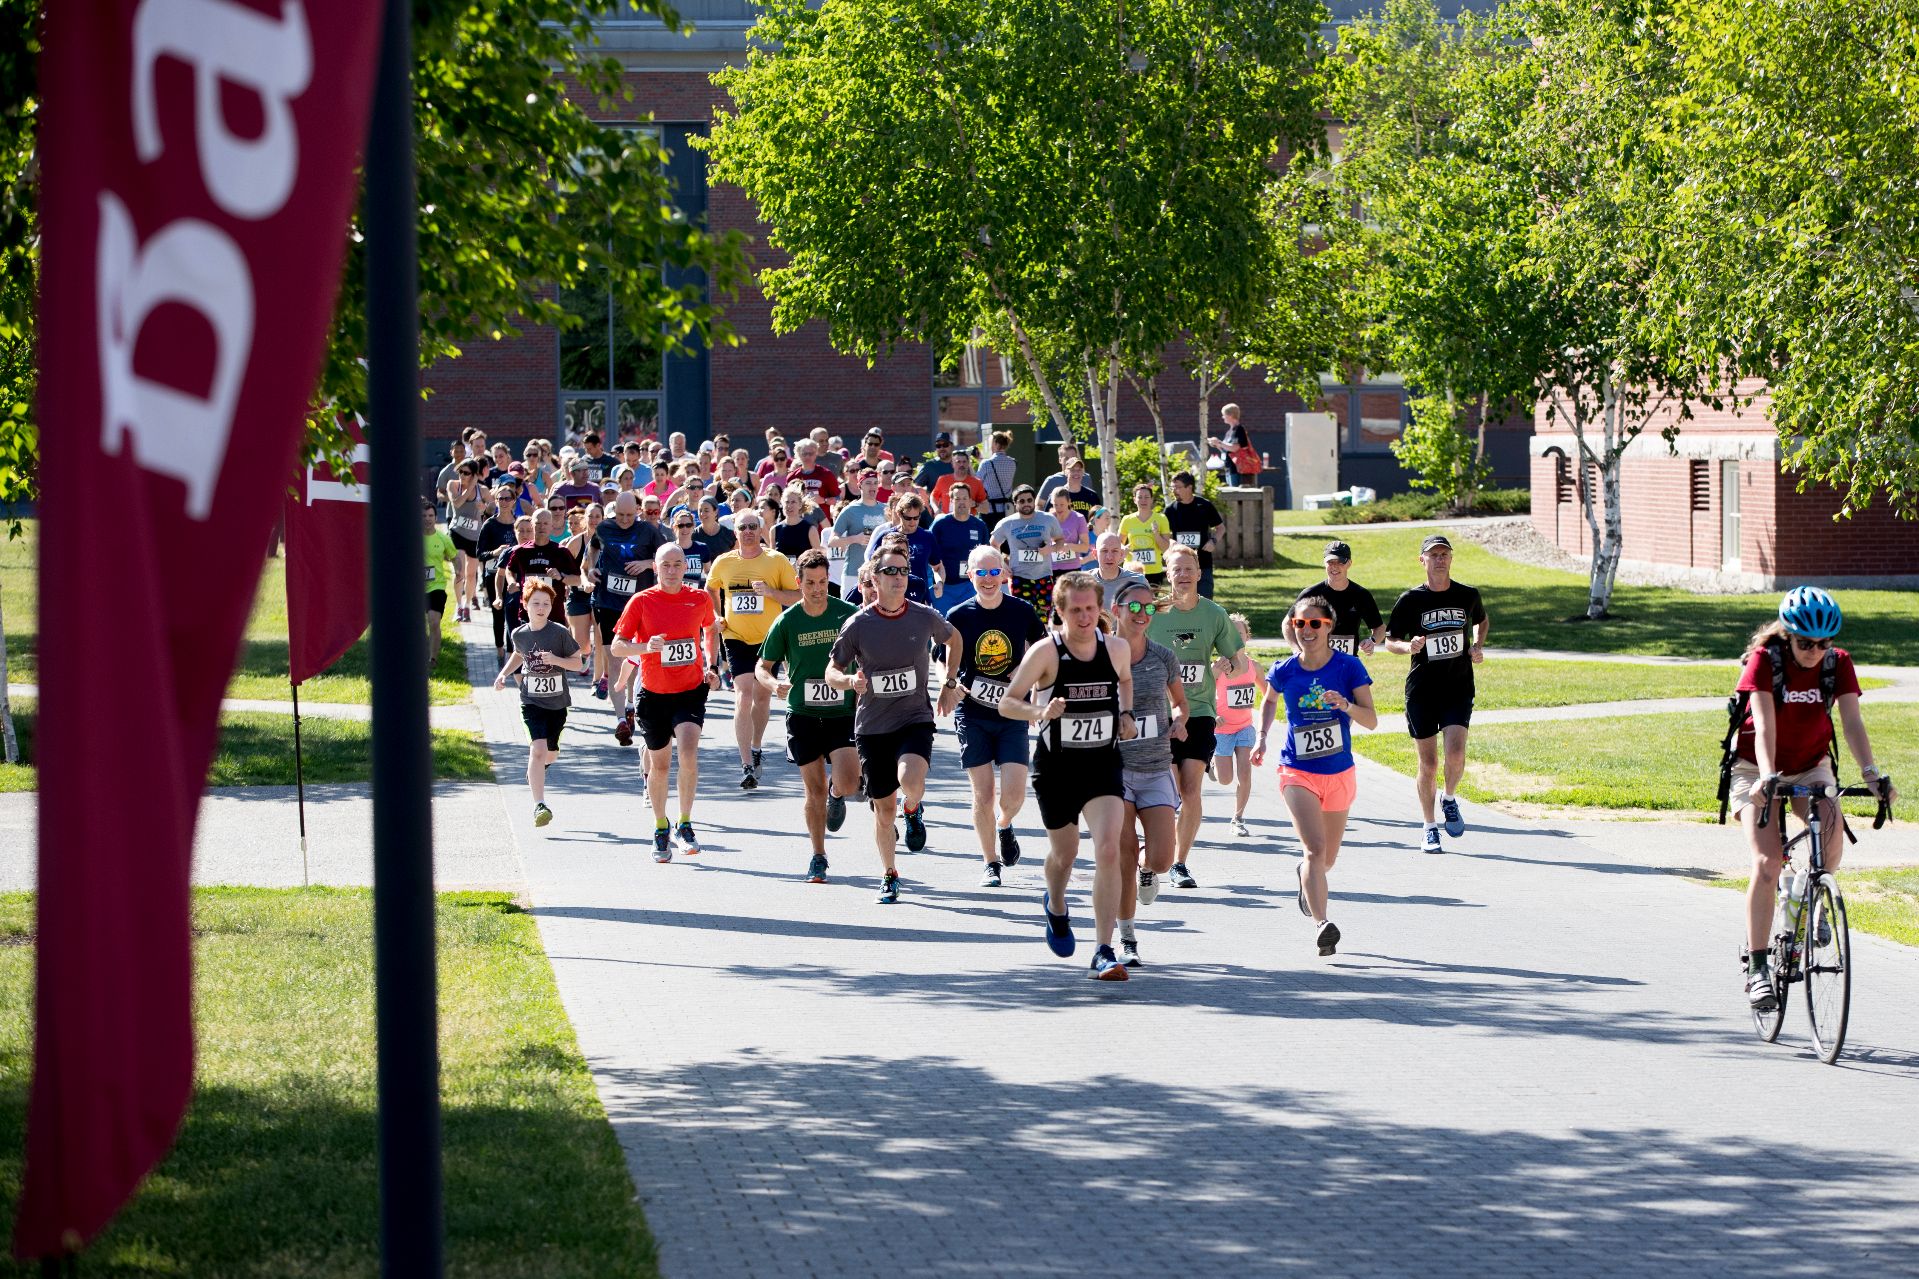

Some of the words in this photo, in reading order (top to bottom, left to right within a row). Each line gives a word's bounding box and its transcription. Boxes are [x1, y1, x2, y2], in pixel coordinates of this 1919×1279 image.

[461, 520, 474, 529] 215
[1181, 535, 1196, 545] 232
[1023, 551, 1039, 561] 227
[1136, 552, 1152, 562] 240
[613, 578, 630, 591] 217
[736, 596, 757, 610] 239
[1423, 610, 1466, 625] UNE
[668, 643, 693, 661] 293
[1434, 636, 1458, 654] 198
[534, 677, 556, 692] 230
[881, 673, 908, 692] 216
[812, 684, 839, 700] 208
[977, 683, 1005, 703] 249
[1068, 685, 1108, 698] BATES
[1234, 688, 1254, 705] 242
[1071, 719, 1103, 740] 274
[1303, 728, 1334, 753] 258
